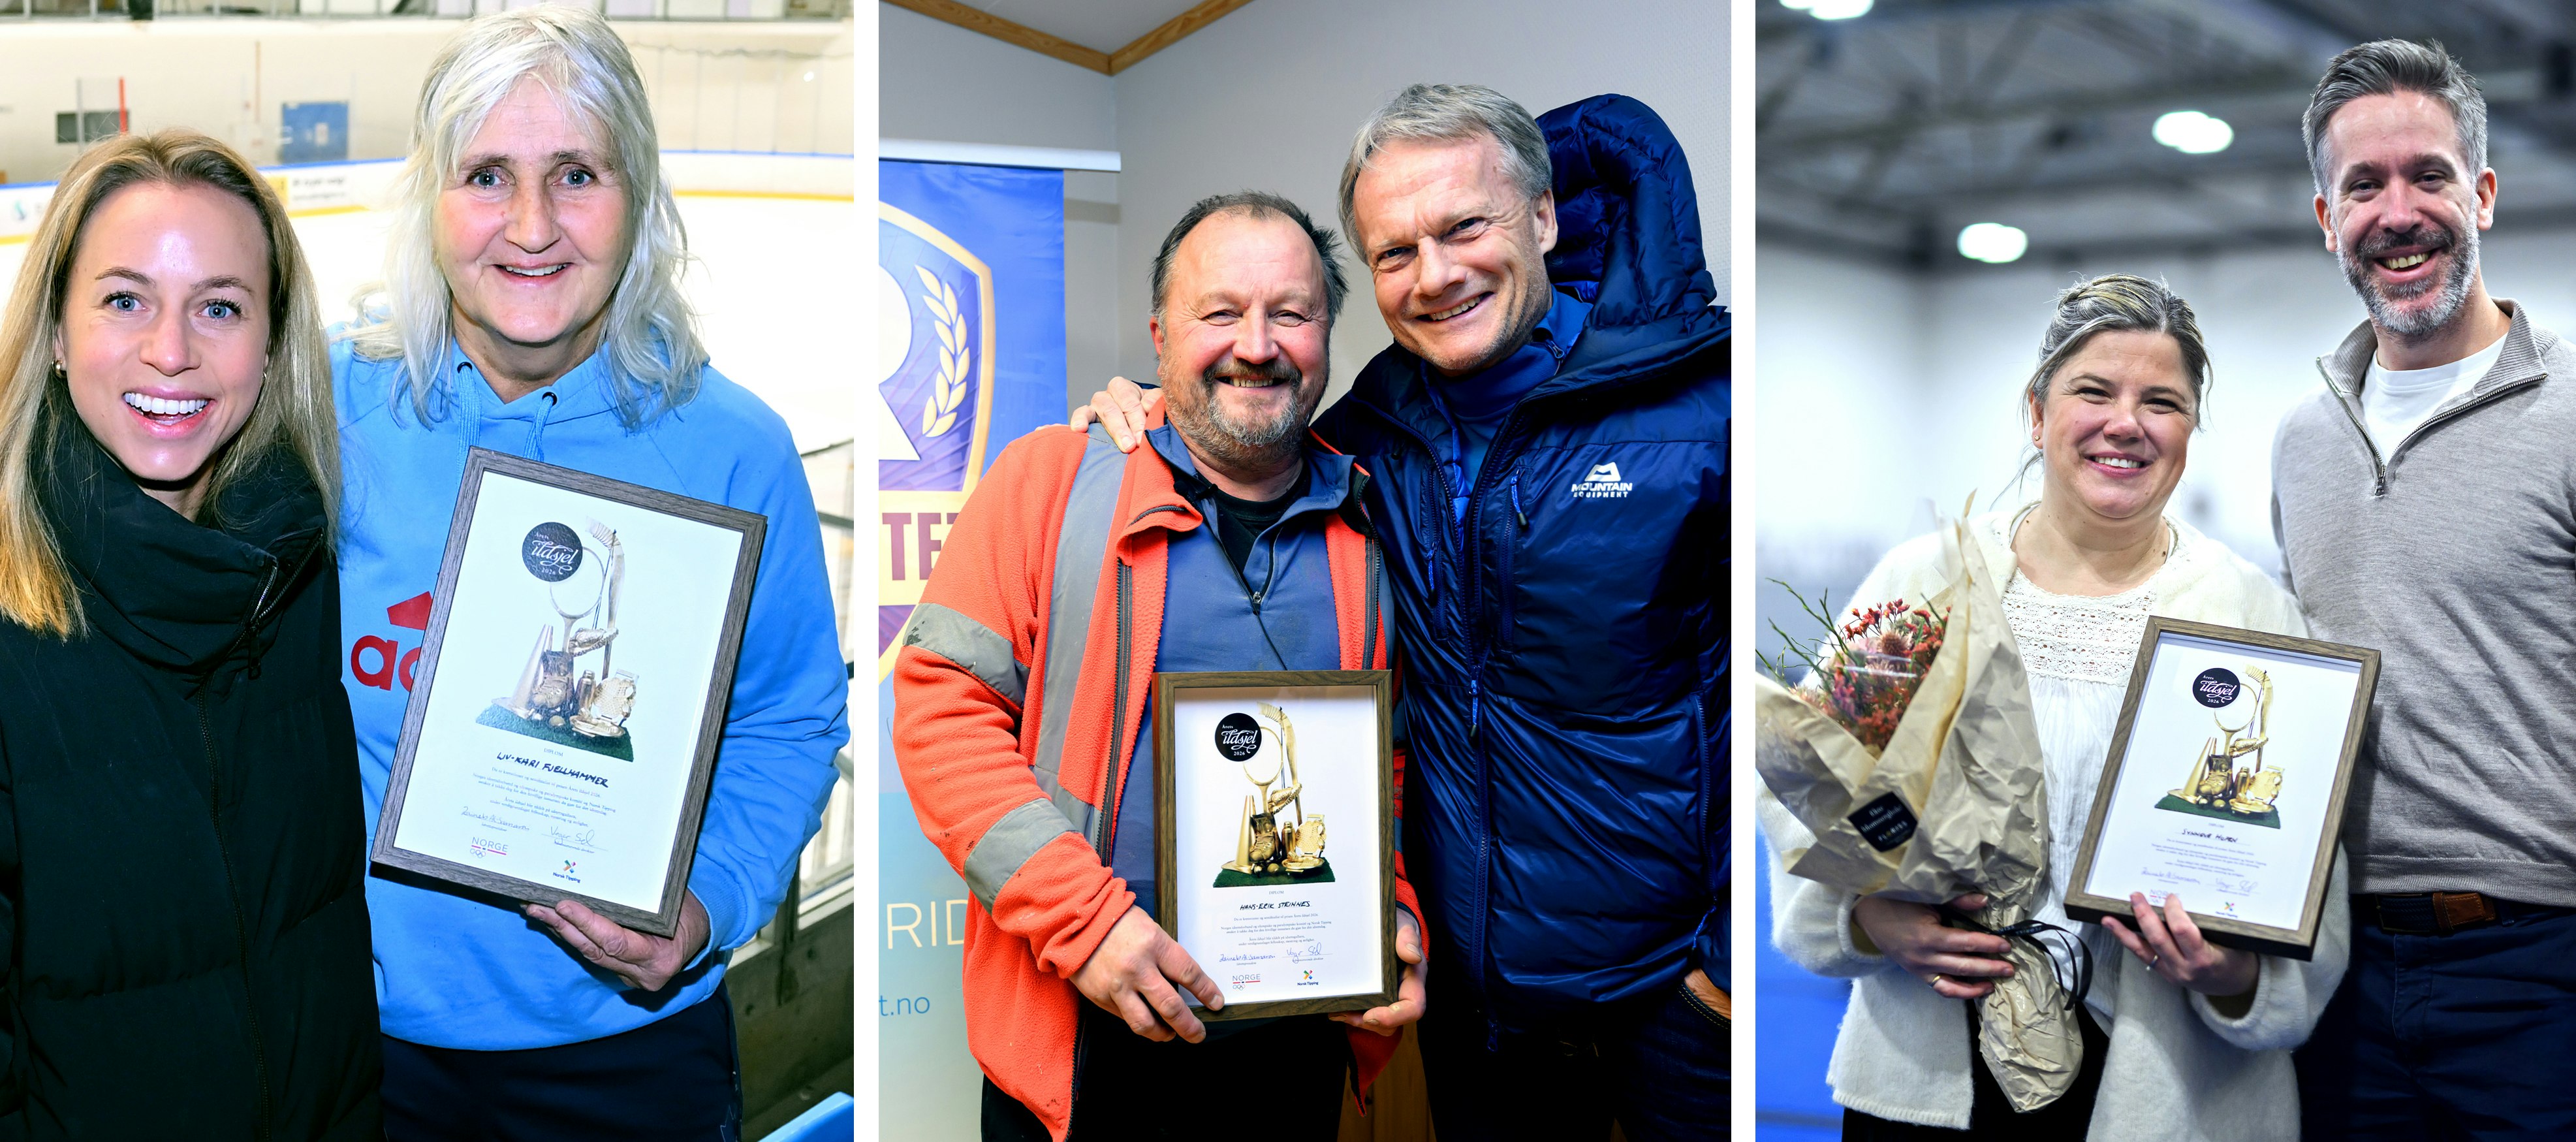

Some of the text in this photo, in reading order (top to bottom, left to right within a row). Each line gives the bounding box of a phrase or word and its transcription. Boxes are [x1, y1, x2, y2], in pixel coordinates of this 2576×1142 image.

[1571, 483, 1633, 492] MOUNTAIN
[531, 539, 579, 575] ildsjel
[2199, 680, 2237, 703] ildsjel
[1221, 729, 1258, 753] ildsjel
[497, 752, 541, 768] LIV-KARI
[542, 763, 609, 788] FJELLHAMMER
[472, 836, 509, 852] NORGE
[566, 875, 580, 883] Tipping
